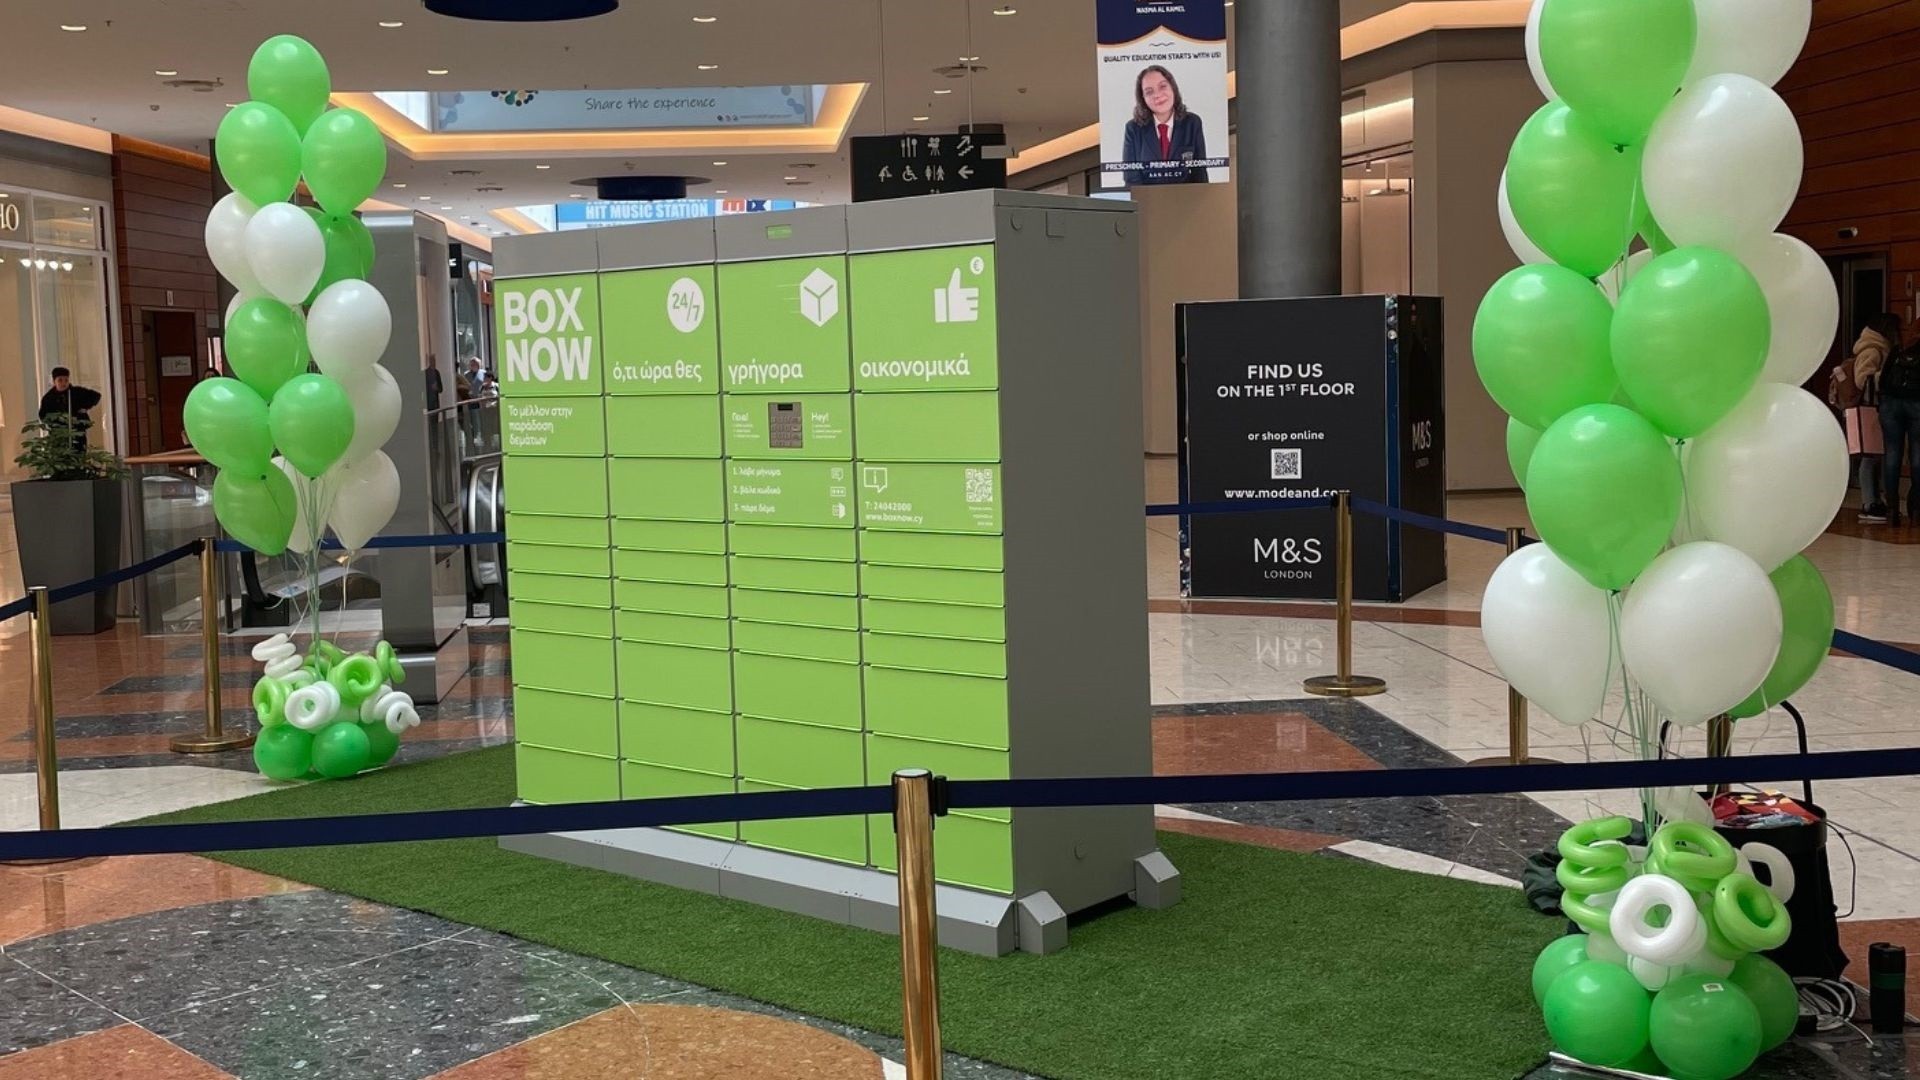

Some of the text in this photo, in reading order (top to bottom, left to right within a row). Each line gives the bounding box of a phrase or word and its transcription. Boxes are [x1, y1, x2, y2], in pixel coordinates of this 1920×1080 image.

[1168, 52, 1192, 60] STARTS
[585, 97, 716, 112] Share the experience
[1105, 162, 1145, 171] PRESCHOOL
[1150, 161, 1179, 169] PRIMARY
[1185, 159, 1225, 168] SECONDARY
[586, 205, 608, 220] HIT
[610, 204, 651, 219] MUSIC
[656, 202, 708, 218] STATION
[503, 287, 584, 335] BOX
[672, 291, 701, 322] 24/7
[505, 336, 593, 382] NOW
[640, 360, 673, 384] ώρα
[674, 360, 703, 382] θες
[728, 358, 804, 384] γρήγορα
[860, 353, 970, 382] οικονομικά
[1247, 363, 1323, 379] FIND US
[1217, 382, 1355, 398] ON THE 1ST FLOOR
[508, 404, 573, 419] Το μέλλον στην
[811, 412, 829, 423] Hey!
[509, 419, 554, 434] παράδοση
[1247, 430, 1325, 443] or shop online
[1224, 487, 1350, 499] www.modeand.co
[865, 501, 873, 510] T:
[1254, 538, 1322, 564] M&S
[1264, 570, 1313, 580] LONDON
